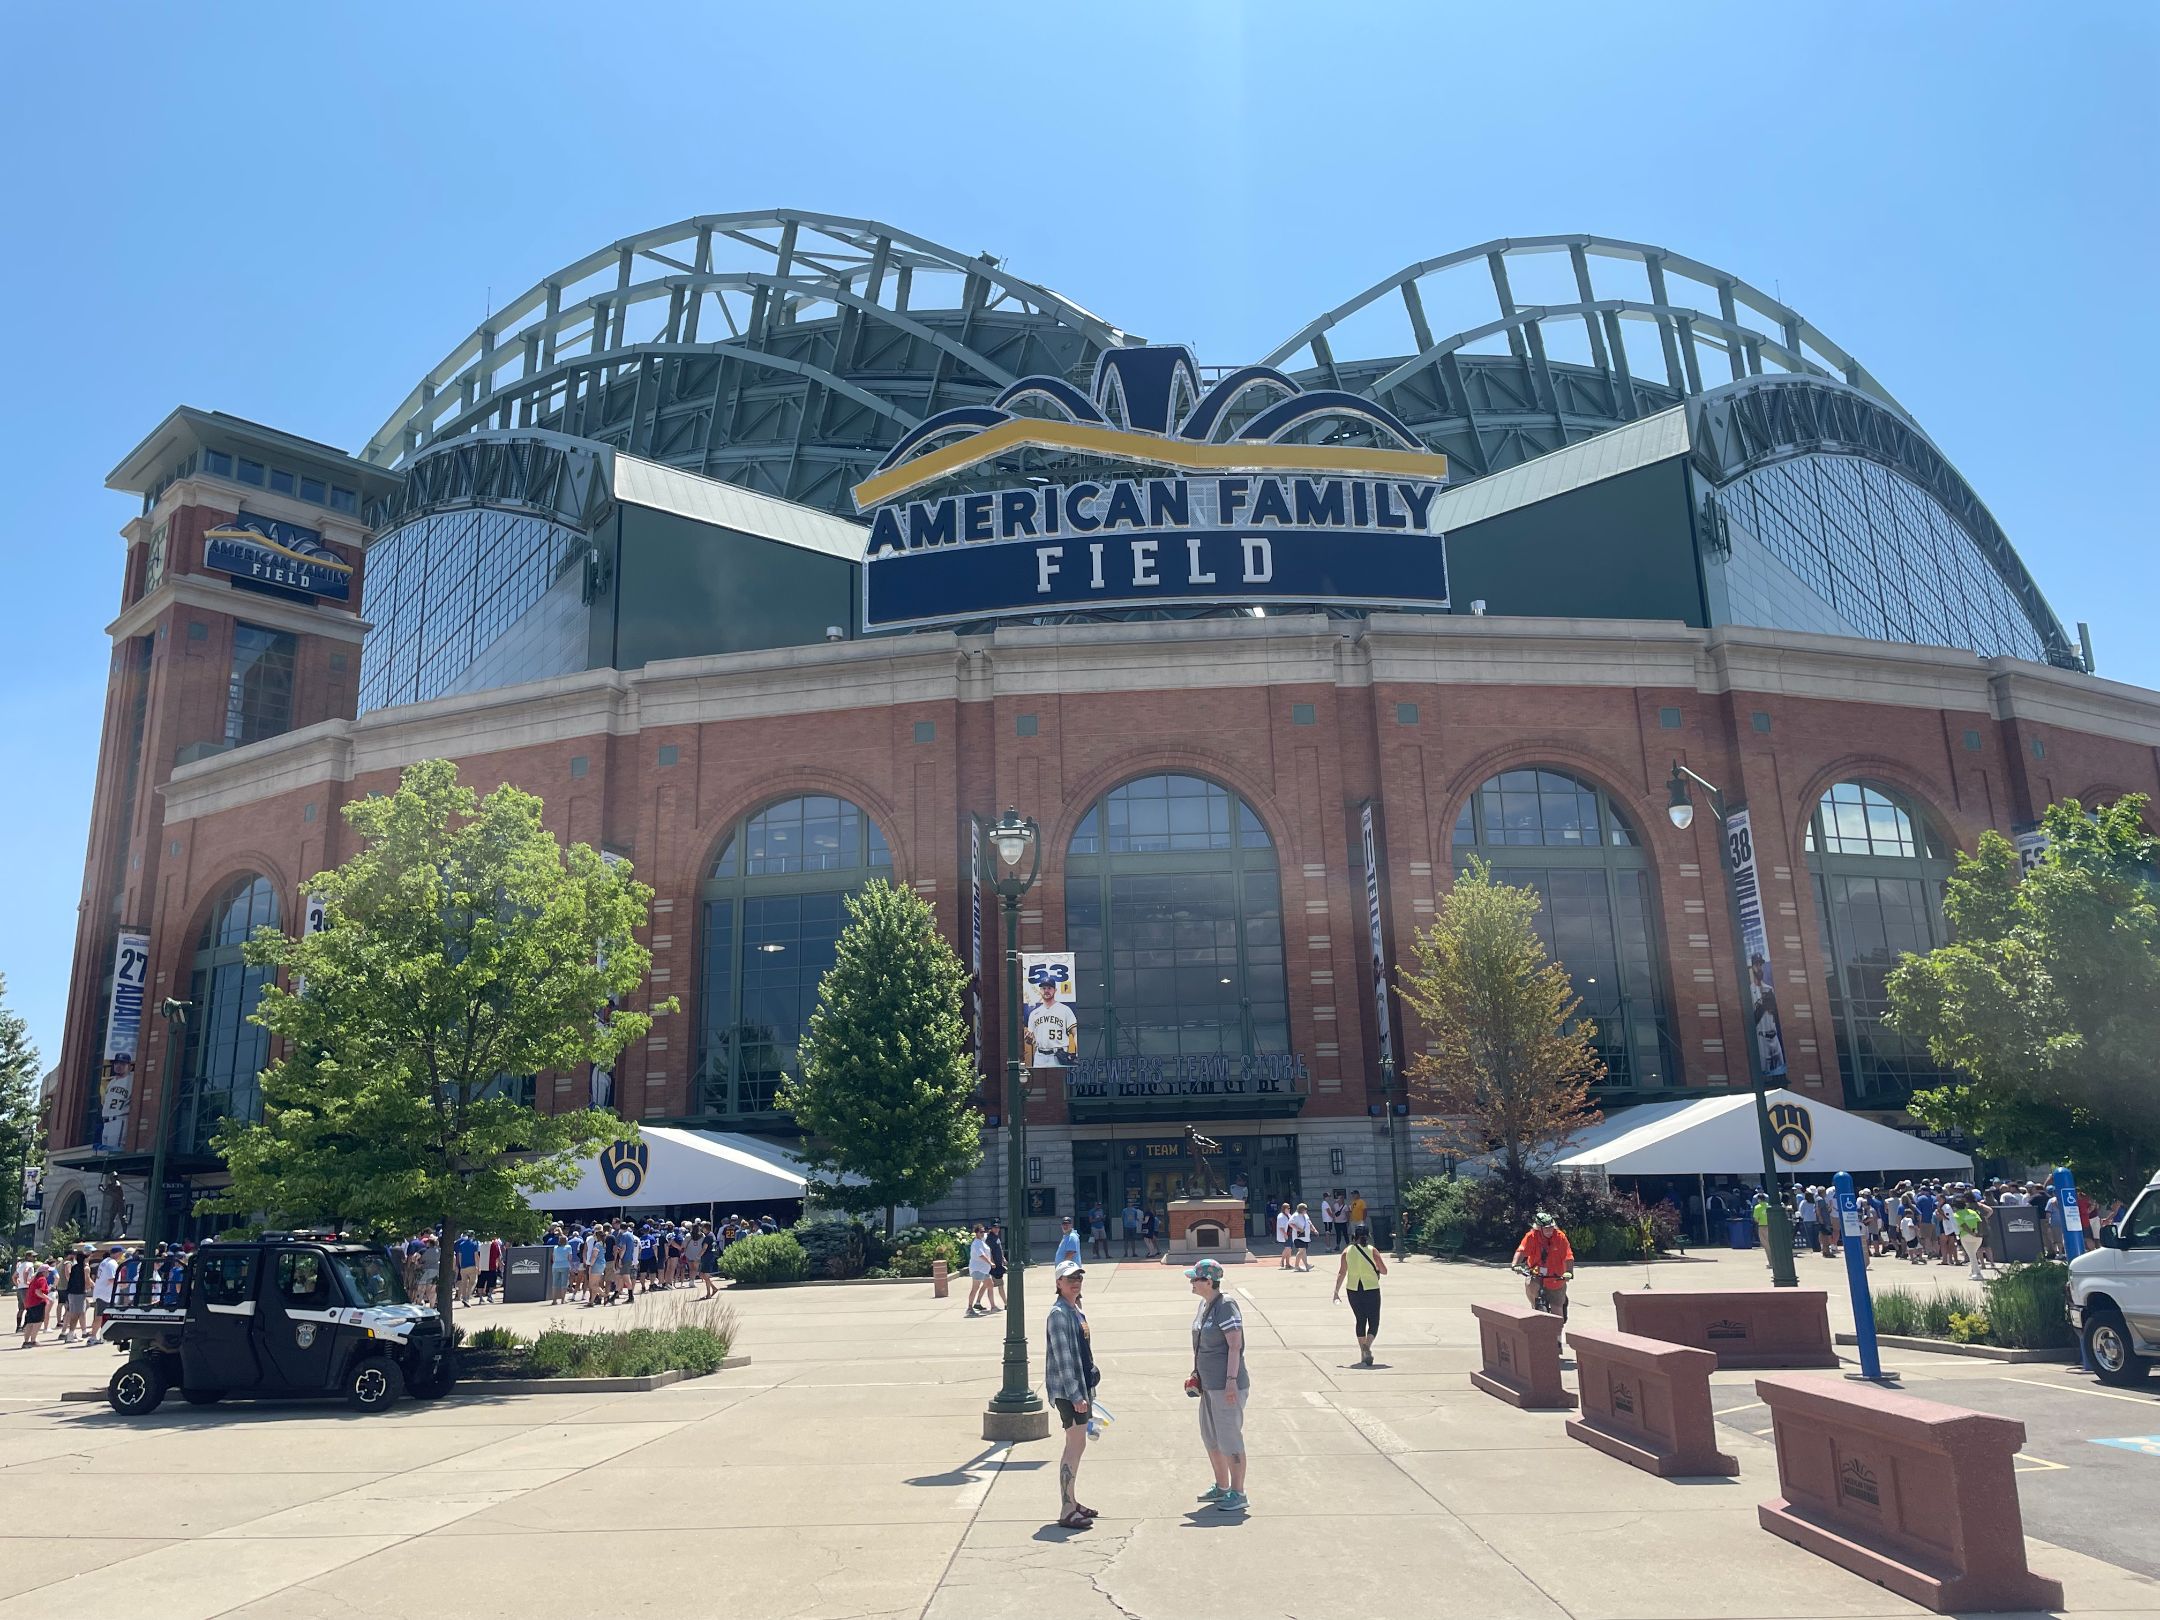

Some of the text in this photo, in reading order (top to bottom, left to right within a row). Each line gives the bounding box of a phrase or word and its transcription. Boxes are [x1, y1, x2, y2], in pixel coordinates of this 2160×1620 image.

[866, 478, 1439, 555] AMERICAN FAMILY
[208, 539, 350, 585] AMERICAN FAMILY
[252, 563, 310, 588] FIELD
[1036, 537, 1273, 593] FIELD
[1729, 827, 1752, 869] 38
[119, 948, 149, 983] 27
[1028, 963, 1069, 984] 53
[111, 982, 145, 1053] ADAMES
[1048, 1029, 1063, 1041] 53
[1066, 1052, 1308, 1086] BREWERS TEAM STORE
[109, 1098, 125, 1110] 27
[1146, 1144, 1178, 1156] TEAM
[640, 1239, 651, 1249] 23
